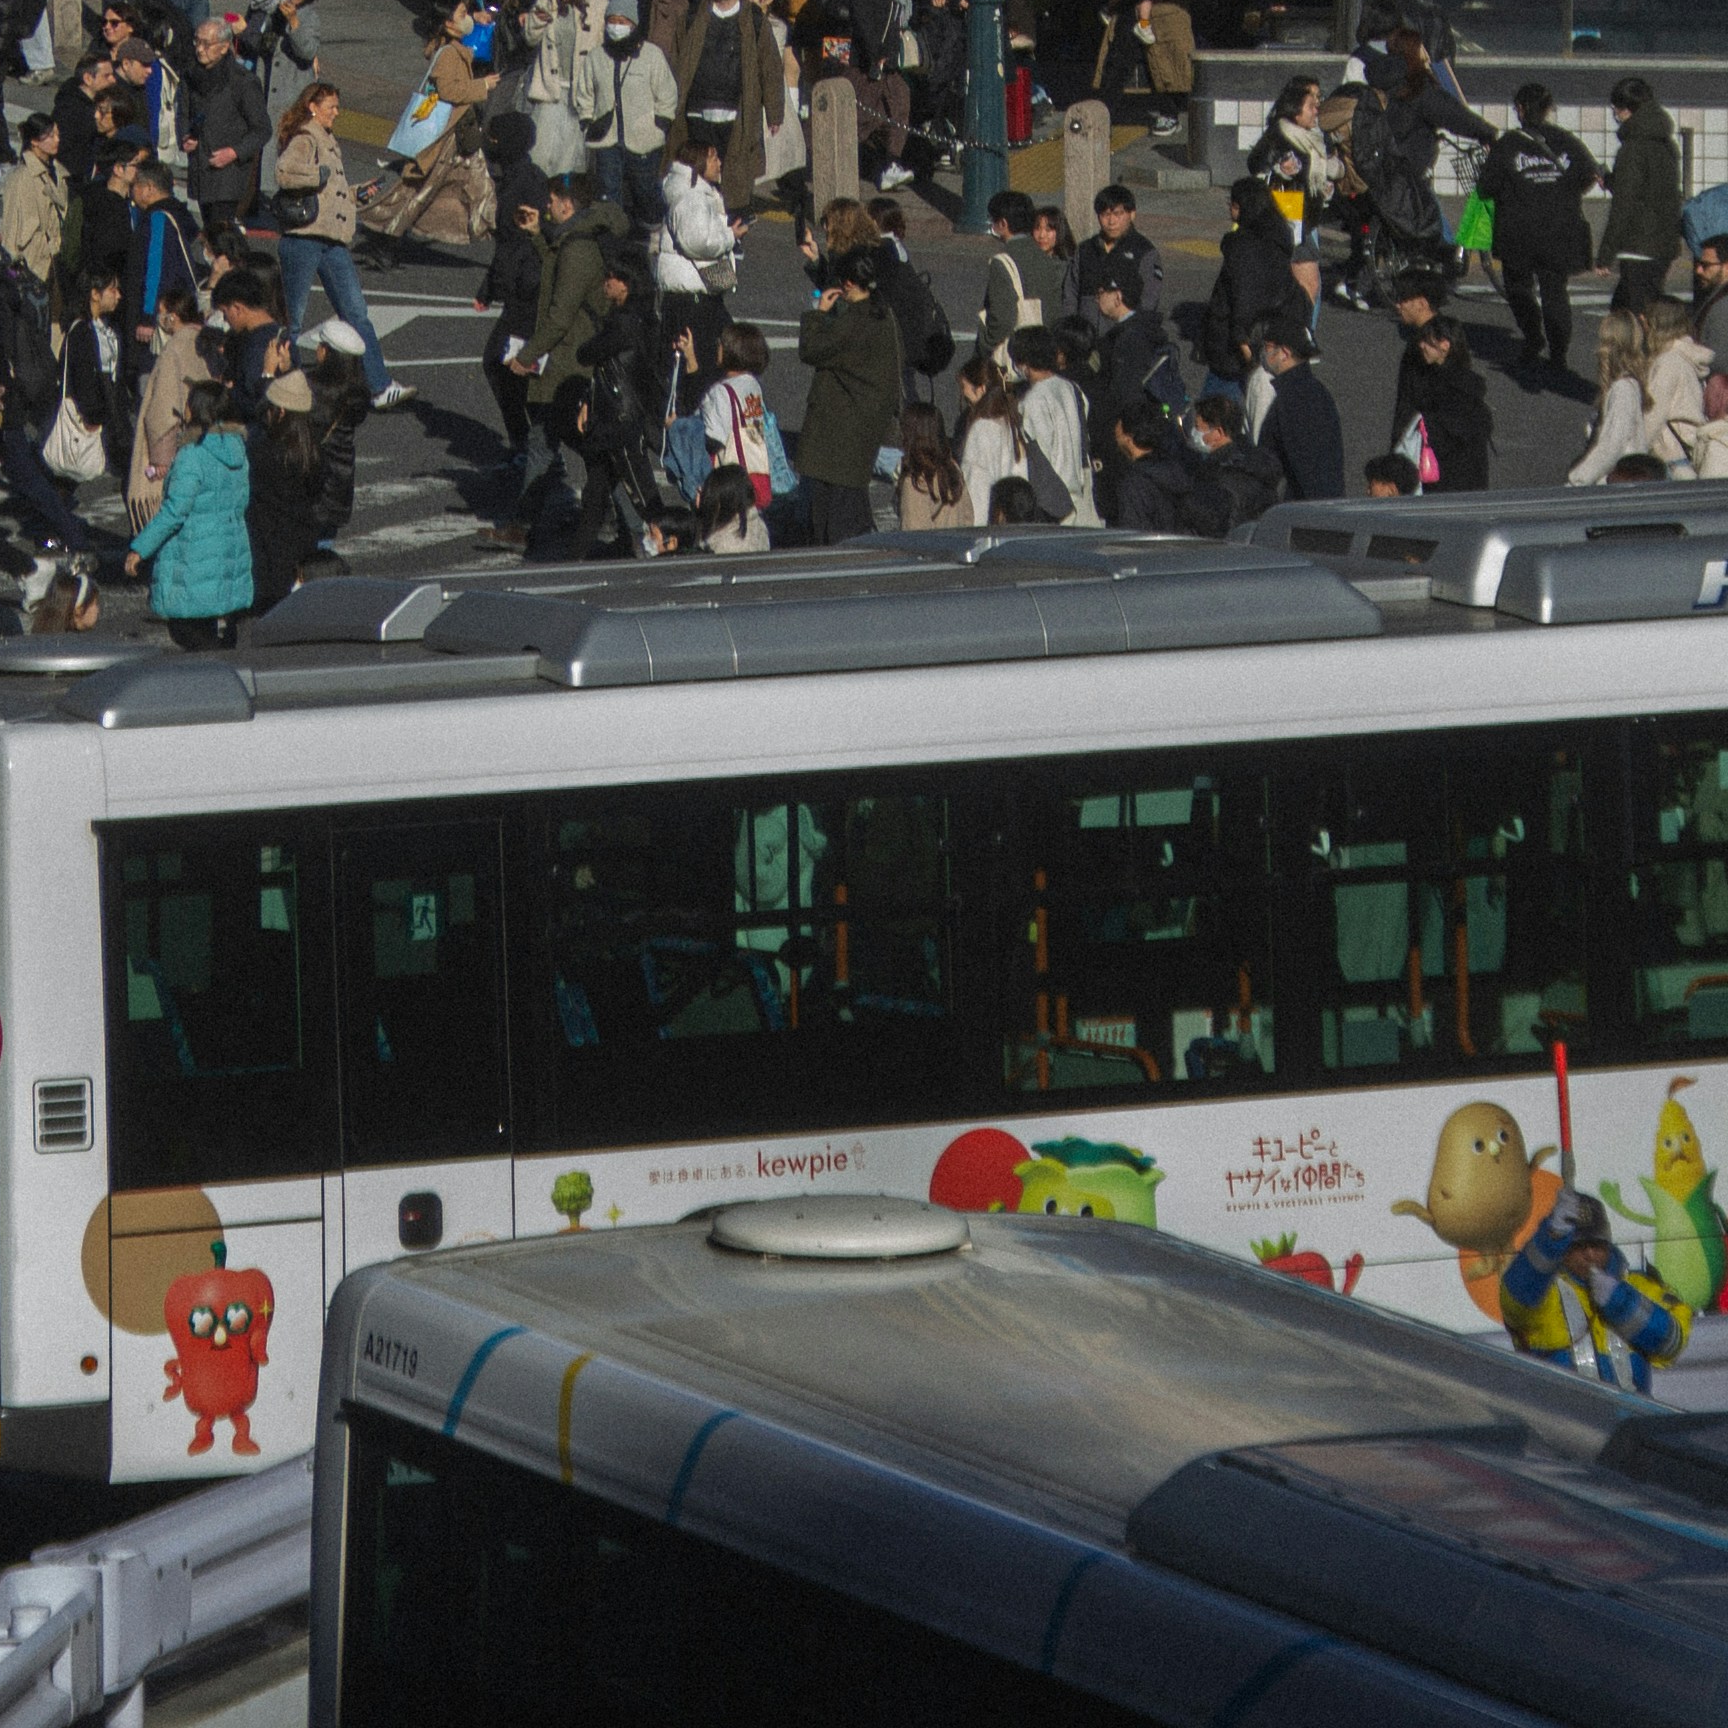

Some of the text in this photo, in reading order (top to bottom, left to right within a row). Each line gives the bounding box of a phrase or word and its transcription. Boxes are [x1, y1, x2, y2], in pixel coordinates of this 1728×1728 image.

[757, 1143, 848, 1181] kewpie
[1225, 1162, 1366, 1199] ヤサイな仲間たち
[363, 1331, 419, 1380] A21719
